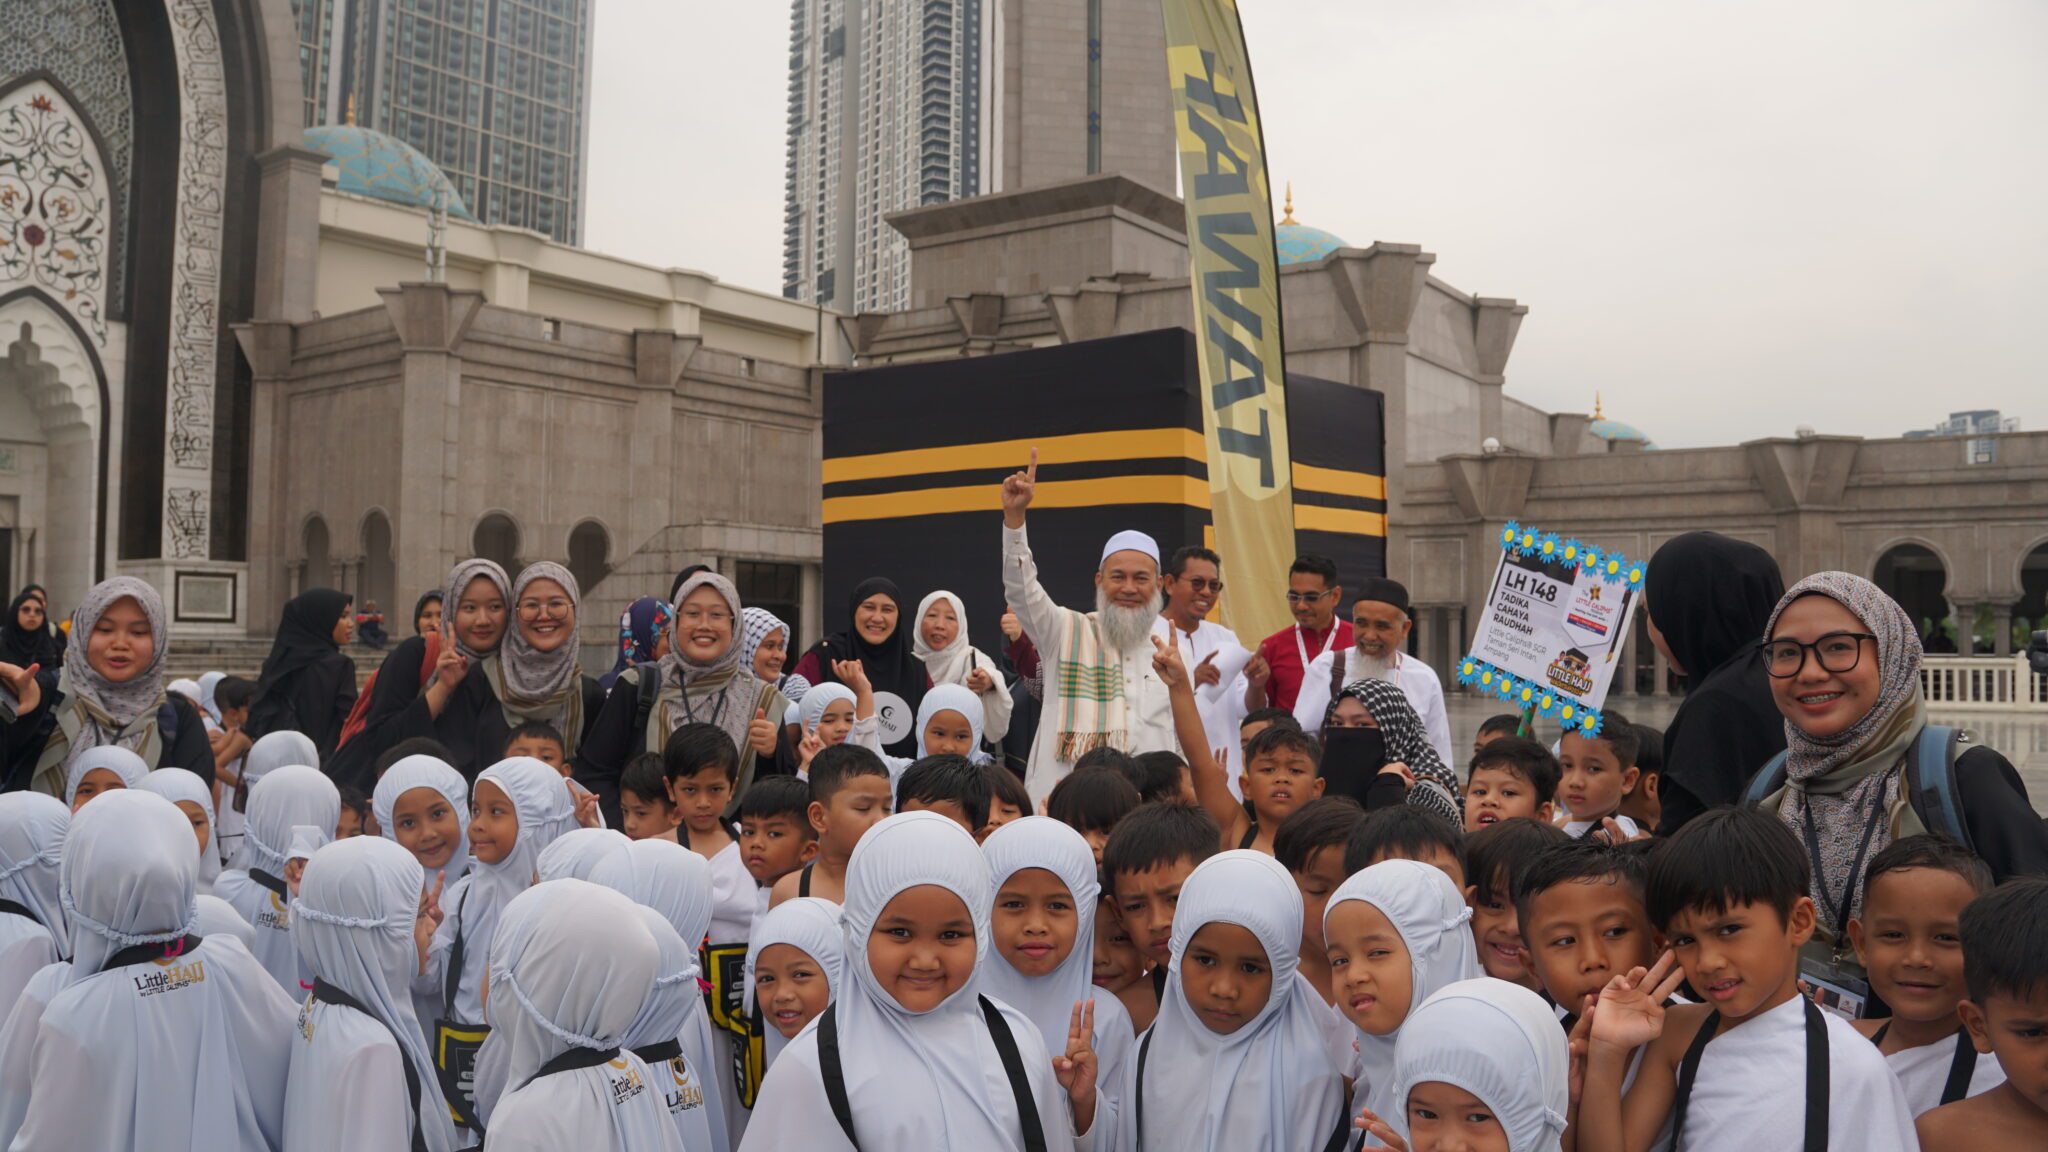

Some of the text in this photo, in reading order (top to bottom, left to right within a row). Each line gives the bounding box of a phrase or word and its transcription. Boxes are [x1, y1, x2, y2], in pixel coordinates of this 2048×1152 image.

[1504, 570, 1557, 602] LH 148
[1501, 591, 1529, 609] TADIKA
[1496, 602, 1529, 622] CAHAYA
[1489, 626, 1505, 638] Little
[1493, 613, 1533, 635] RAUDHAH
[1487, 634, 1507, 649] Taman
[1483, 644, 1510, 662] Ampang
[1548, 665, 1571, 684] LITTLE
[1572, 675, 1592, 693] HAJJ
